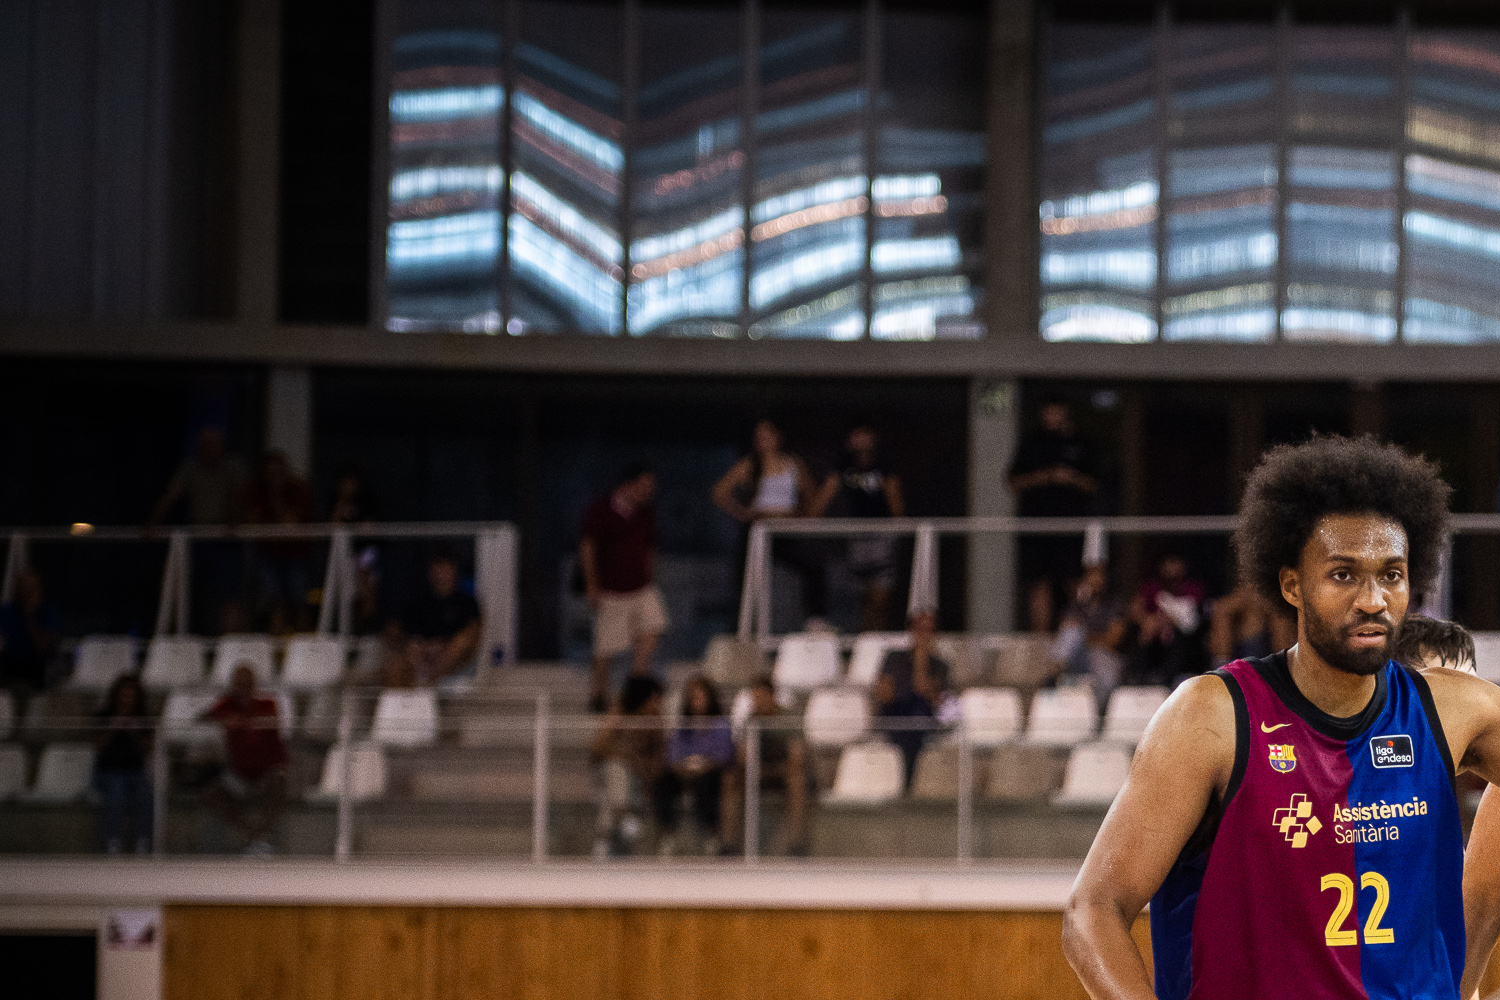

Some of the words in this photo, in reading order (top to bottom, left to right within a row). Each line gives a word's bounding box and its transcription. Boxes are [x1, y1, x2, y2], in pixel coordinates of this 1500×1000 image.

[1376, 746, 1393, 756] liga
[1377, 753, 1412, 763] endesa
[1333, 796, 1427, 823] Assistència
[1334, 821, 1399, 844] Sanitària
[1320, 871, 1395, 946] 22
